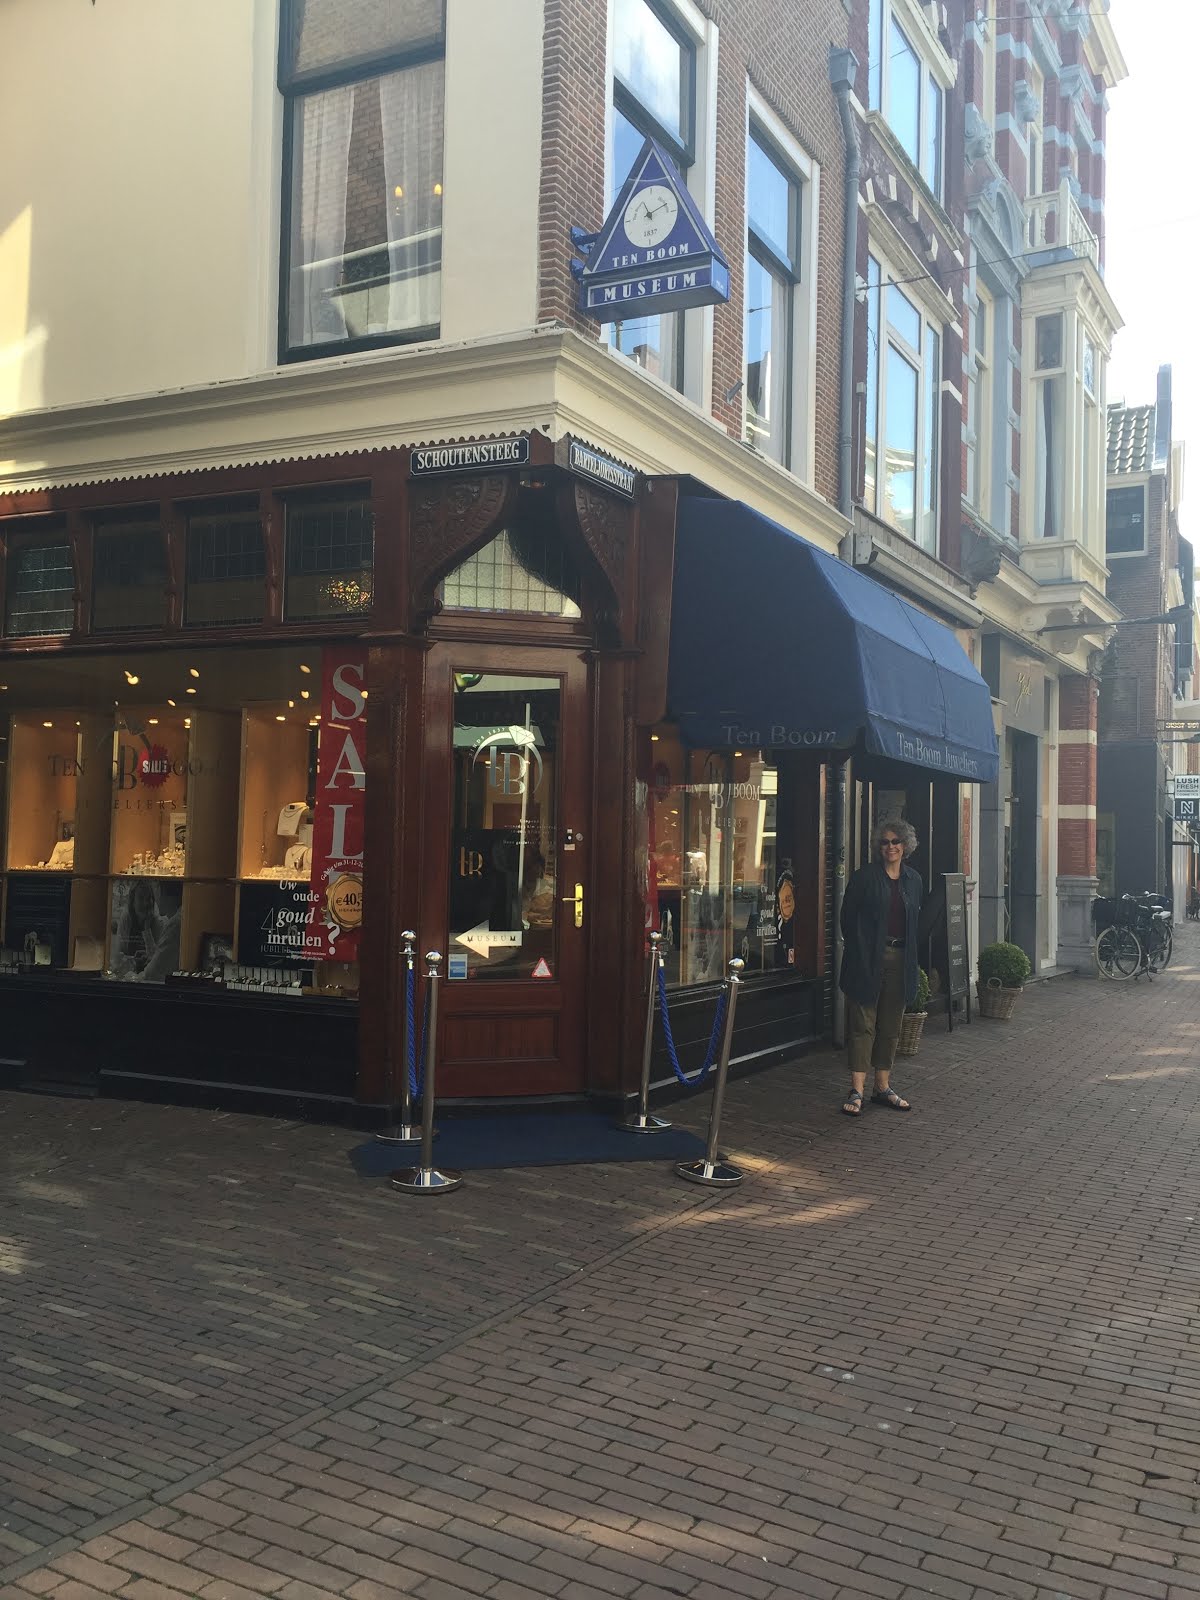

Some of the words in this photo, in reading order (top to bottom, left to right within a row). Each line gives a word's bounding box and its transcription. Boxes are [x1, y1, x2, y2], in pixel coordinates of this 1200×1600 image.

[643, 228, 658, 237] 1837
[612, 252, 638, 267] TEN
[646, 242, 689, 261] BOOM
[603, 271, 697, 302] MUSEUM
[417, 441, 520, 470] SCHOUTENSTEEG
[721, 725, 761, 745] Ten
[771, 725, 838, 745] Boom
[896, 731, 915, 758] Ten
[916, 738, 942, 766] Boom
[944, 745, 979, 776] Juweliers
[732, 783, 760, 801] BOOM
[1180, 800, 1194, 814] N
[279, 880, 297, 891] Uw
[292, 890, 320, 902] oude
[275, 907, 316, 928] goud
[267, 930, 322, 947] inruilen
[327, 922, 341, 955] ?
